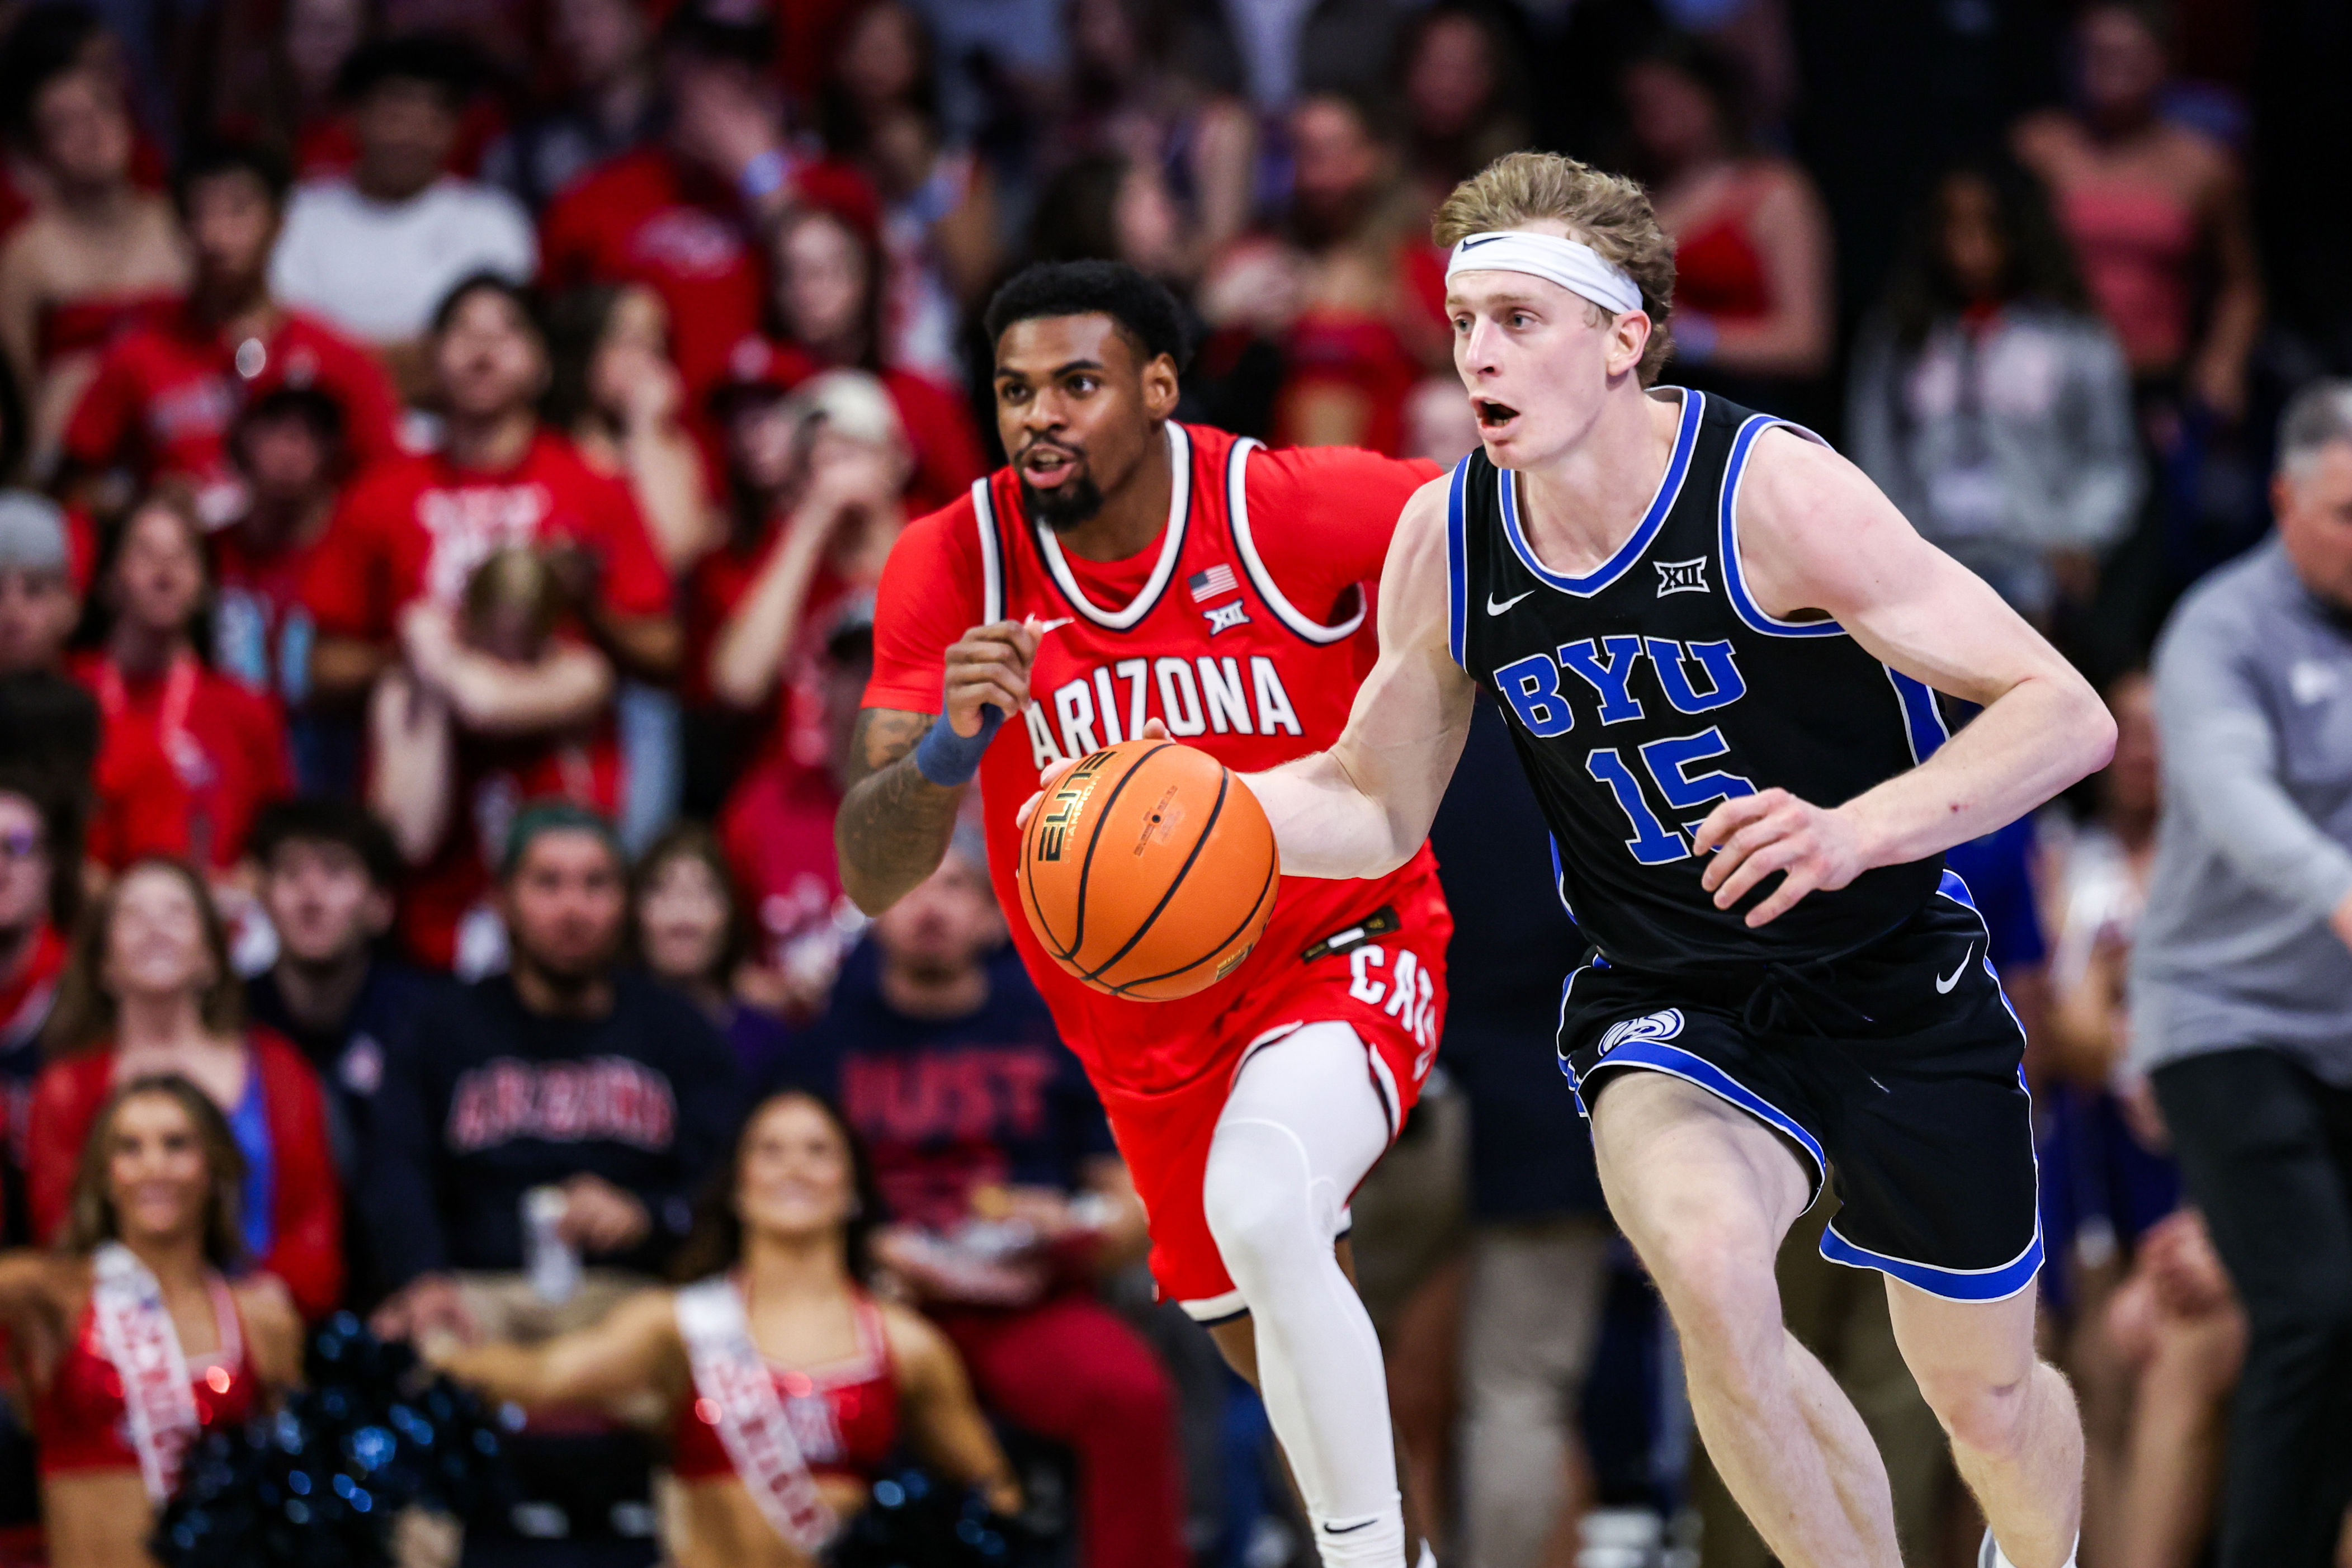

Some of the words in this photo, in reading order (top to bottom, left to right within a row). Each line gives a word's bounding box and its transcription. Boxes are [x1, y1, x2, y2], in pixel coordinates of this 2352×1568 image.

[1024, 655, 1303, 771] ARIZONA
[1493, 634, 1747, 738] BYU
[1038, 751, 1118, 861] ELITE
[1585, 725, 1760, 865] 15
